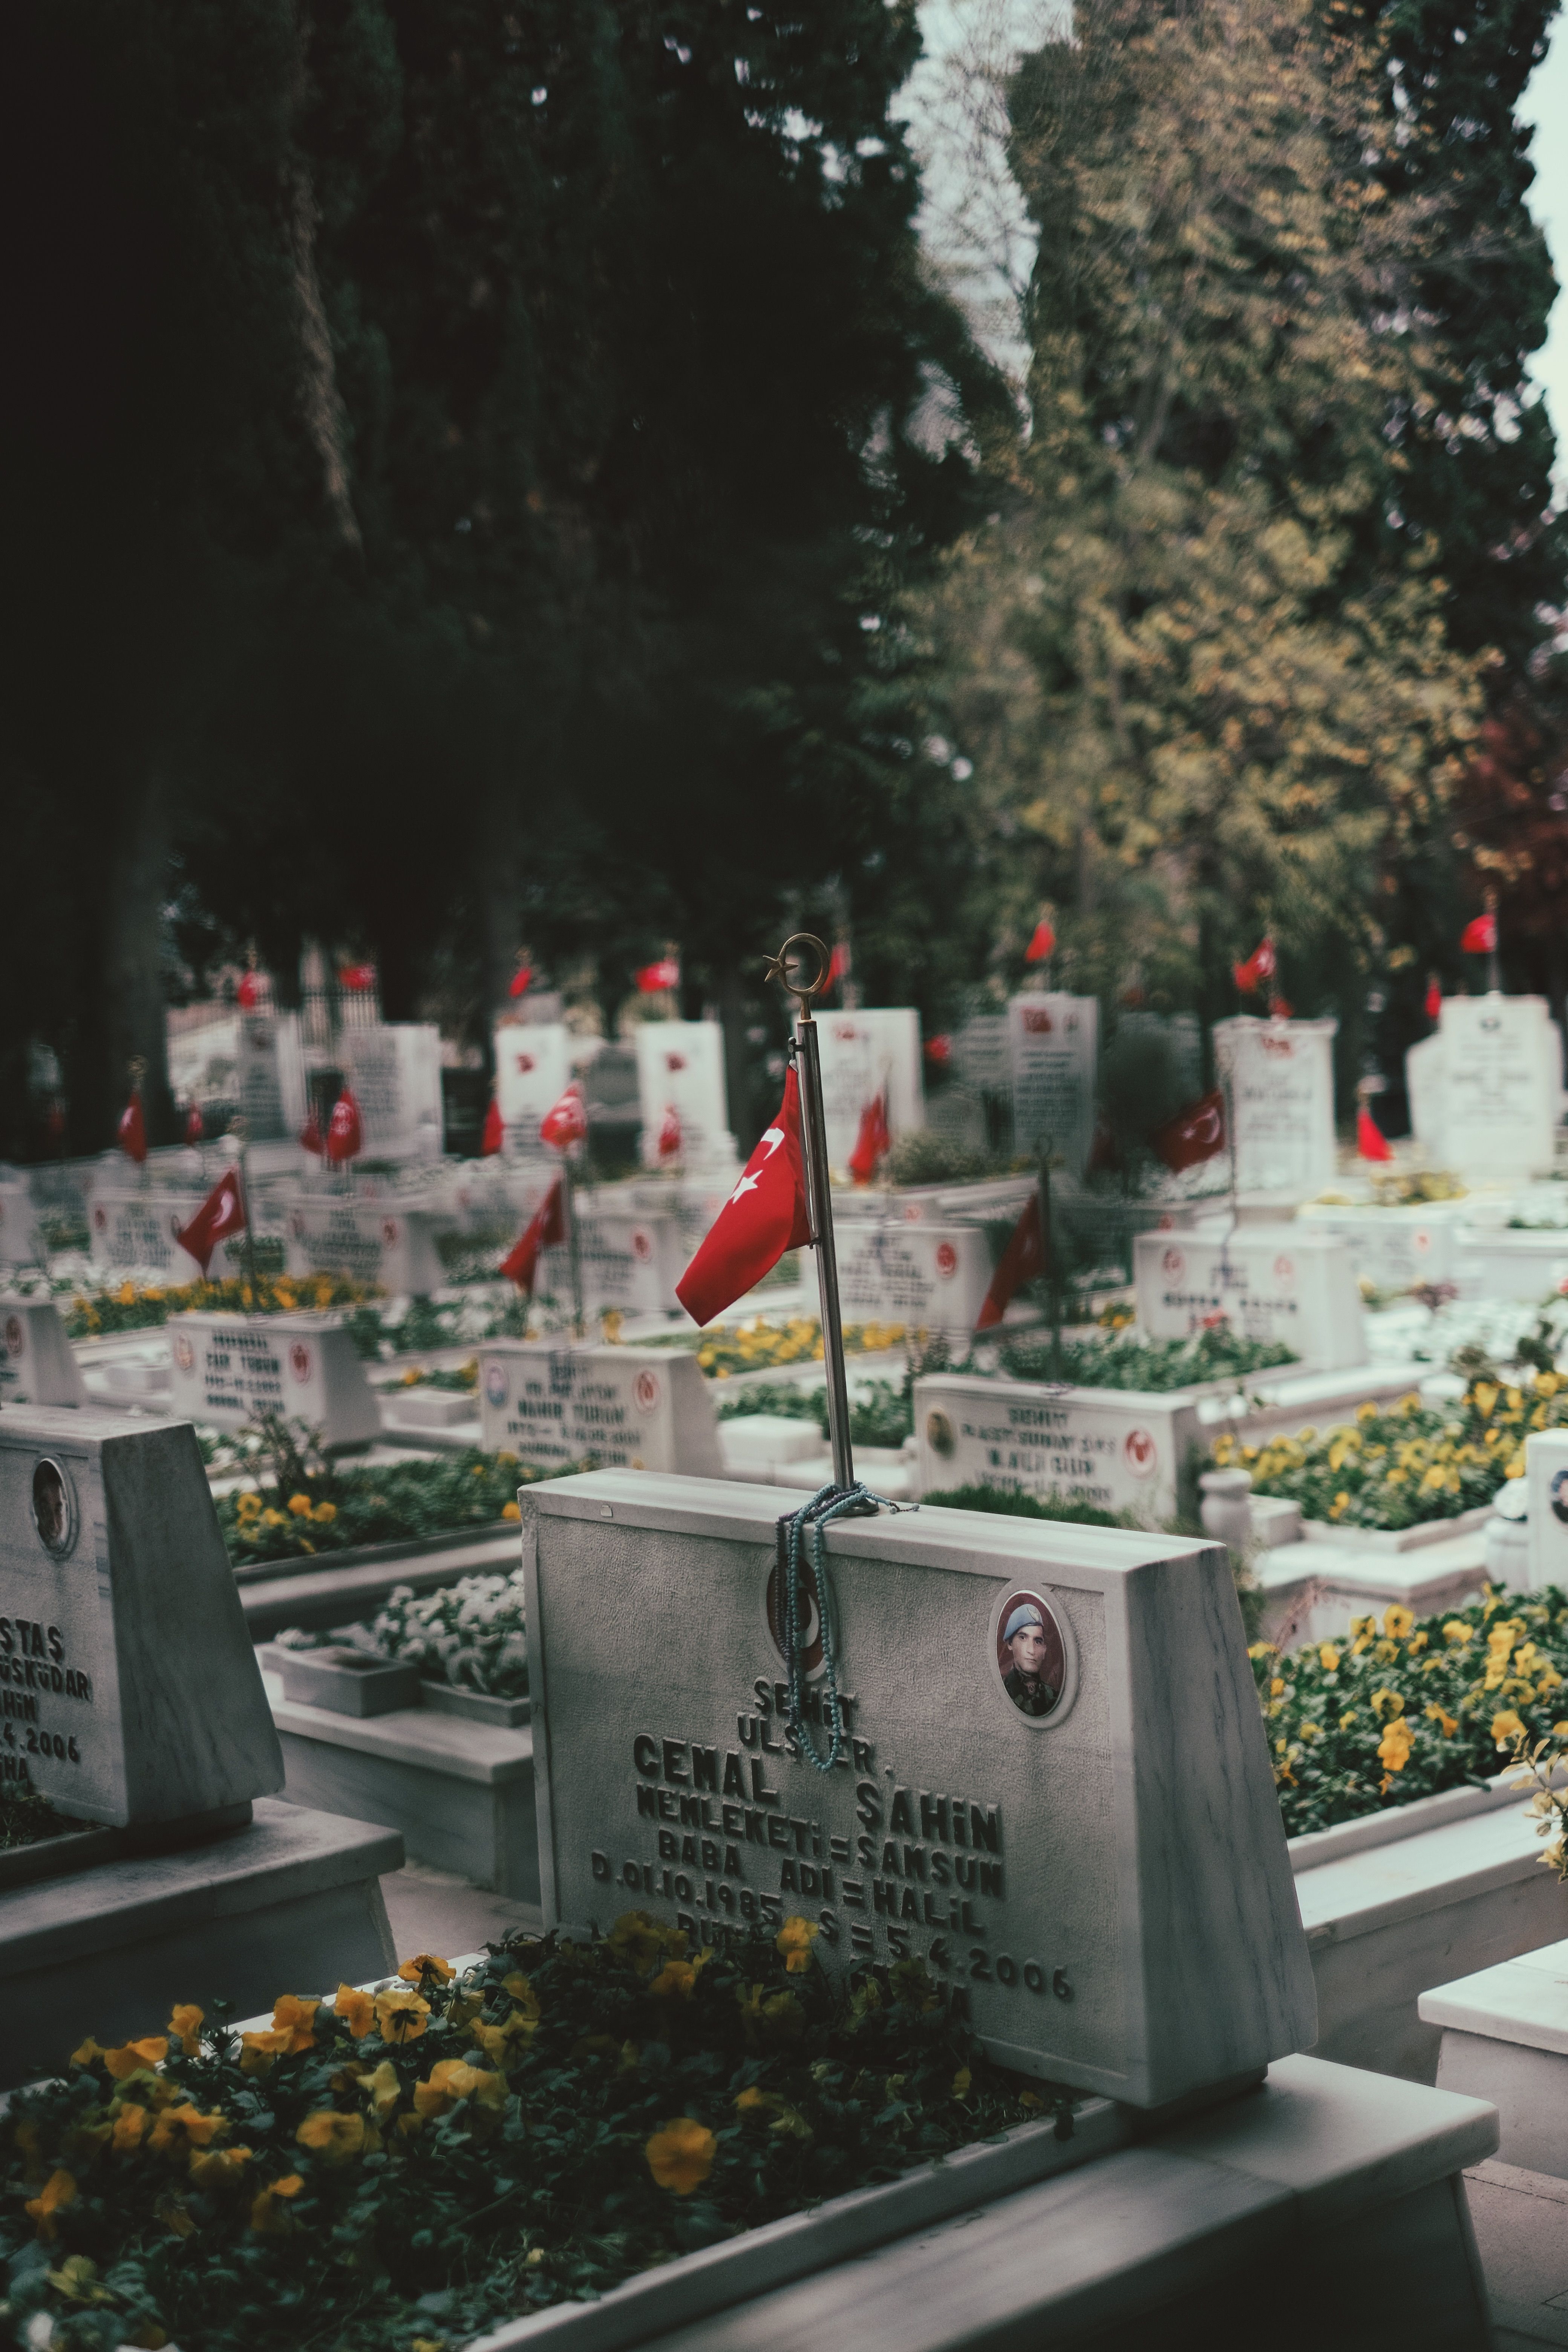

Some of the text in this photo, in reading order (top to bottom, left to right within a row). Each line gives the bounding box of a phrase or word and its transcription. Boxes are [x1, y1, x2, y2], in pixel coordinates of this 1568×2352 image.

[632, 1732, 780, 1804] CEMAL
[658, 1827, 743, 1877] BABA
[780, 1856, 833, 1900] ADI
